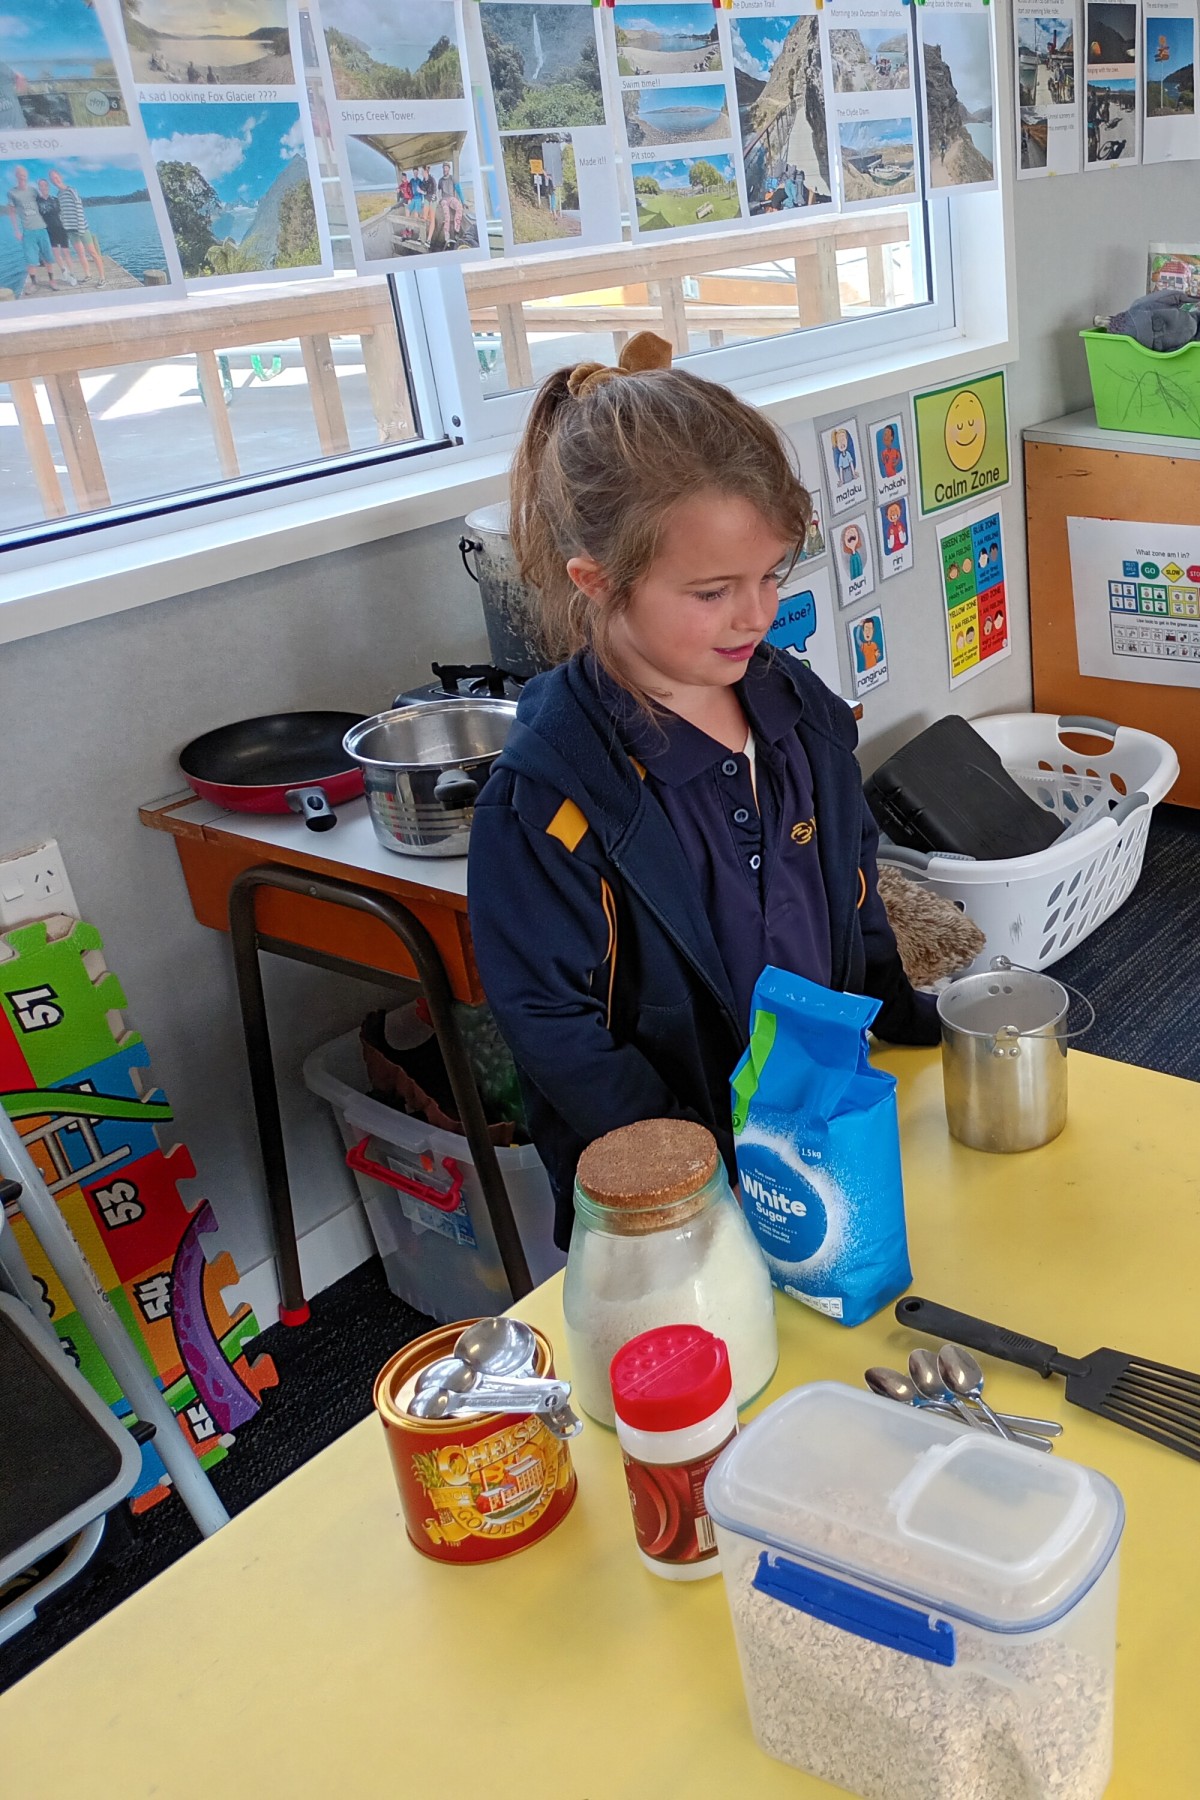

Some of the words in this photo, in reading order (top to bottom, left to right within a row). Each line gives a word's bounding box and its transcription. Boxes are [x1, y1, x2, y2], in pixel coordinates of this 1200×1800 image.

[622, 80, 640, 88] Swim
[138, 91, 147, 101] A
[149, 90, 167, 102] sad
[169, 89, 206, 104] looking
[208, 90, 225, 101] Fox
[227, 90, 256, 102] Glacier
[258, 90, 278, 101] ????
[341, 110, 364, 122] Ships
[366, 110, 389, 121] Creek
[390, 110, 416, 121] Tower.
[10, 138, 30, 150] tea
[32, 136, 63, 152] stop.
[579, 157, 595, 167] Made
[631, 151, 640, 160] Pit
[836, 483, 862, 504] mataku
[935, 478, 968, 503] Calm
[971, 466, 1000, 490] Zone
[985, 518, 998, 531] ZONE
[1144, 567, 1156, 575] GO
[789, 602, 812, 623] koe?
[857, 666, 887, 688] rangirua
[5, 983, 64, 1033] 51
[740, 1168, 807, 1217] White
[90, 1178, 146, 1231] 53
[755, 1201, 787, 1225] Sugar
[133, 1271, 173, 1325] 54
[436, 1417, 544, 1487] CHELSE
[458, 1509, 525, 1535] GOLDEN
